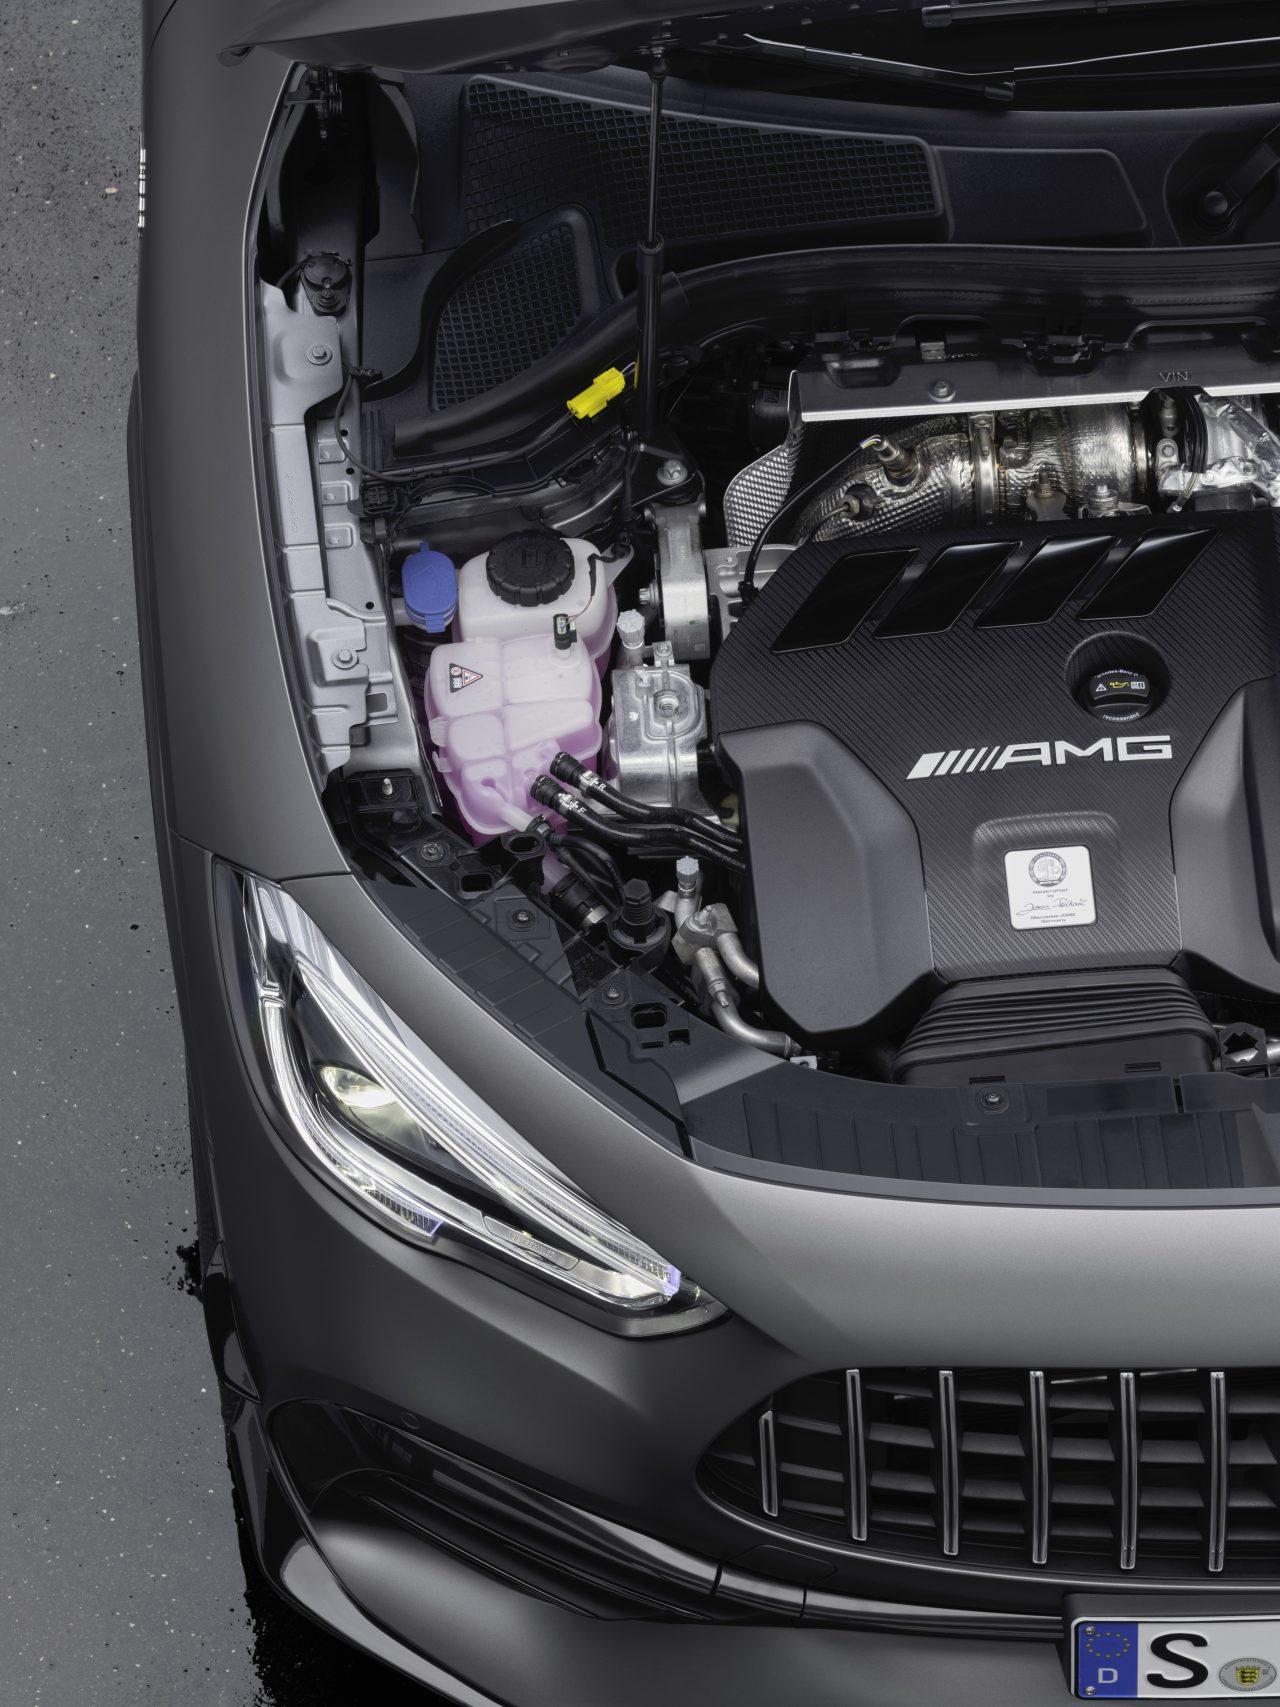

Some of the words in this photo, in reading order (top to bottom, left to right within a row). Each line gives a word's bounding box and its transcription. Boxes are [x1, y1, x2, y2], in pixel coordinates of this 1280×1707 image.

[1160, 371, 1188, 383] VIN
[992, 735, 1173, 770] AMG
[1146, 1633, 1209, 1689] S
[1097, 1667, 1118, 1684] D
